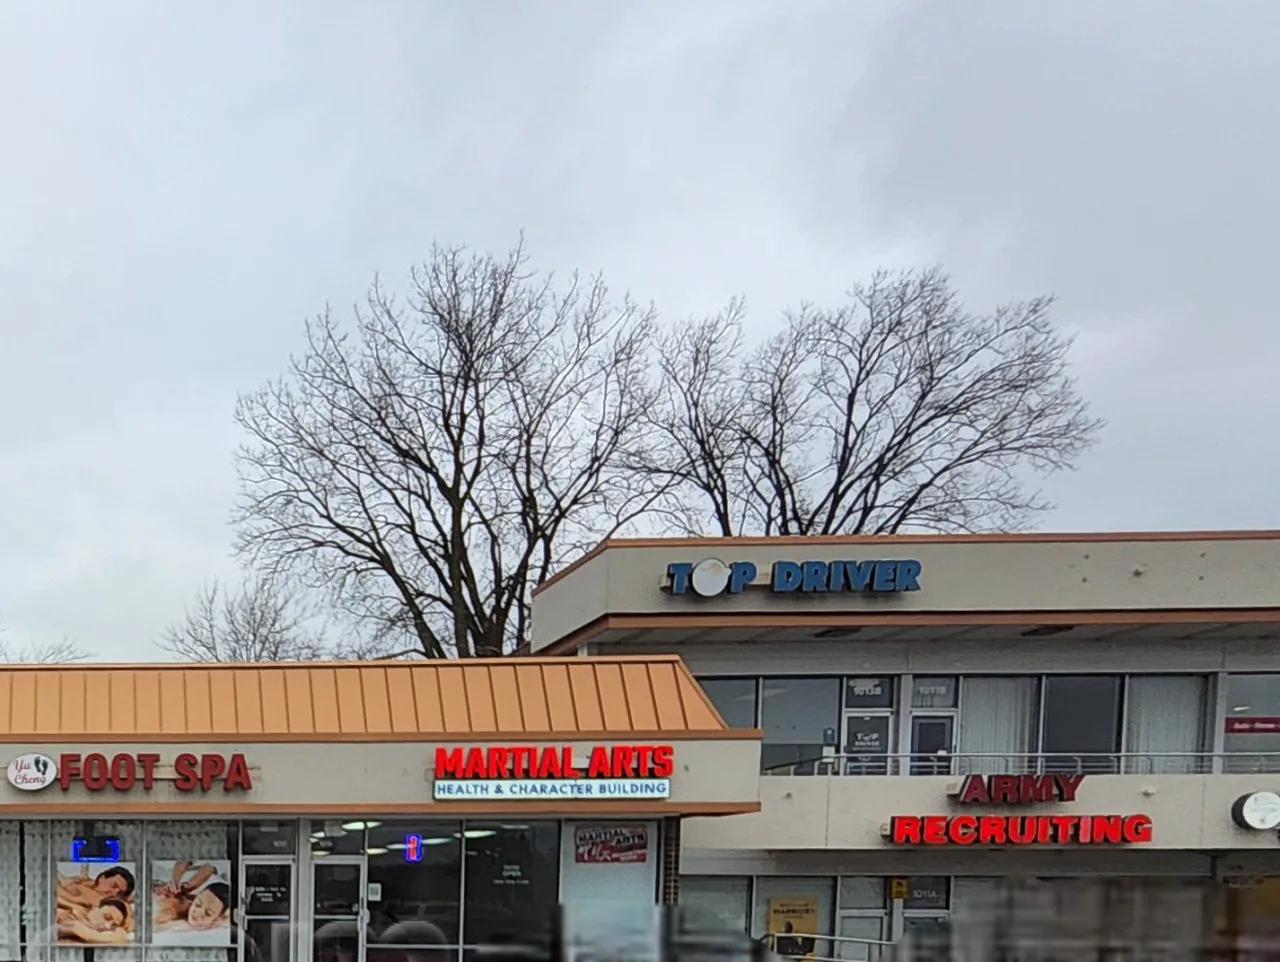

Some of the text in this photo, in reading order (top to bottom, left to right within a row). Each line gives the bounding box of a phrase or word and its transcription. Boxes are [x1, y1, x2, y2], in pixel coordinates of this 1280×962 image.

[773, 560, 922, 593] DRIVER
[60, 752, 252, 791] FOOT SPA
[435, 745, 674, 779] MARTIAL ARTS
[437, 783, 667, 795] HEALTH & CHARACTER BUILDING
[959, 773, 1086, 802] ARMY
[891, 815, 1152, 844] RECRUITING
